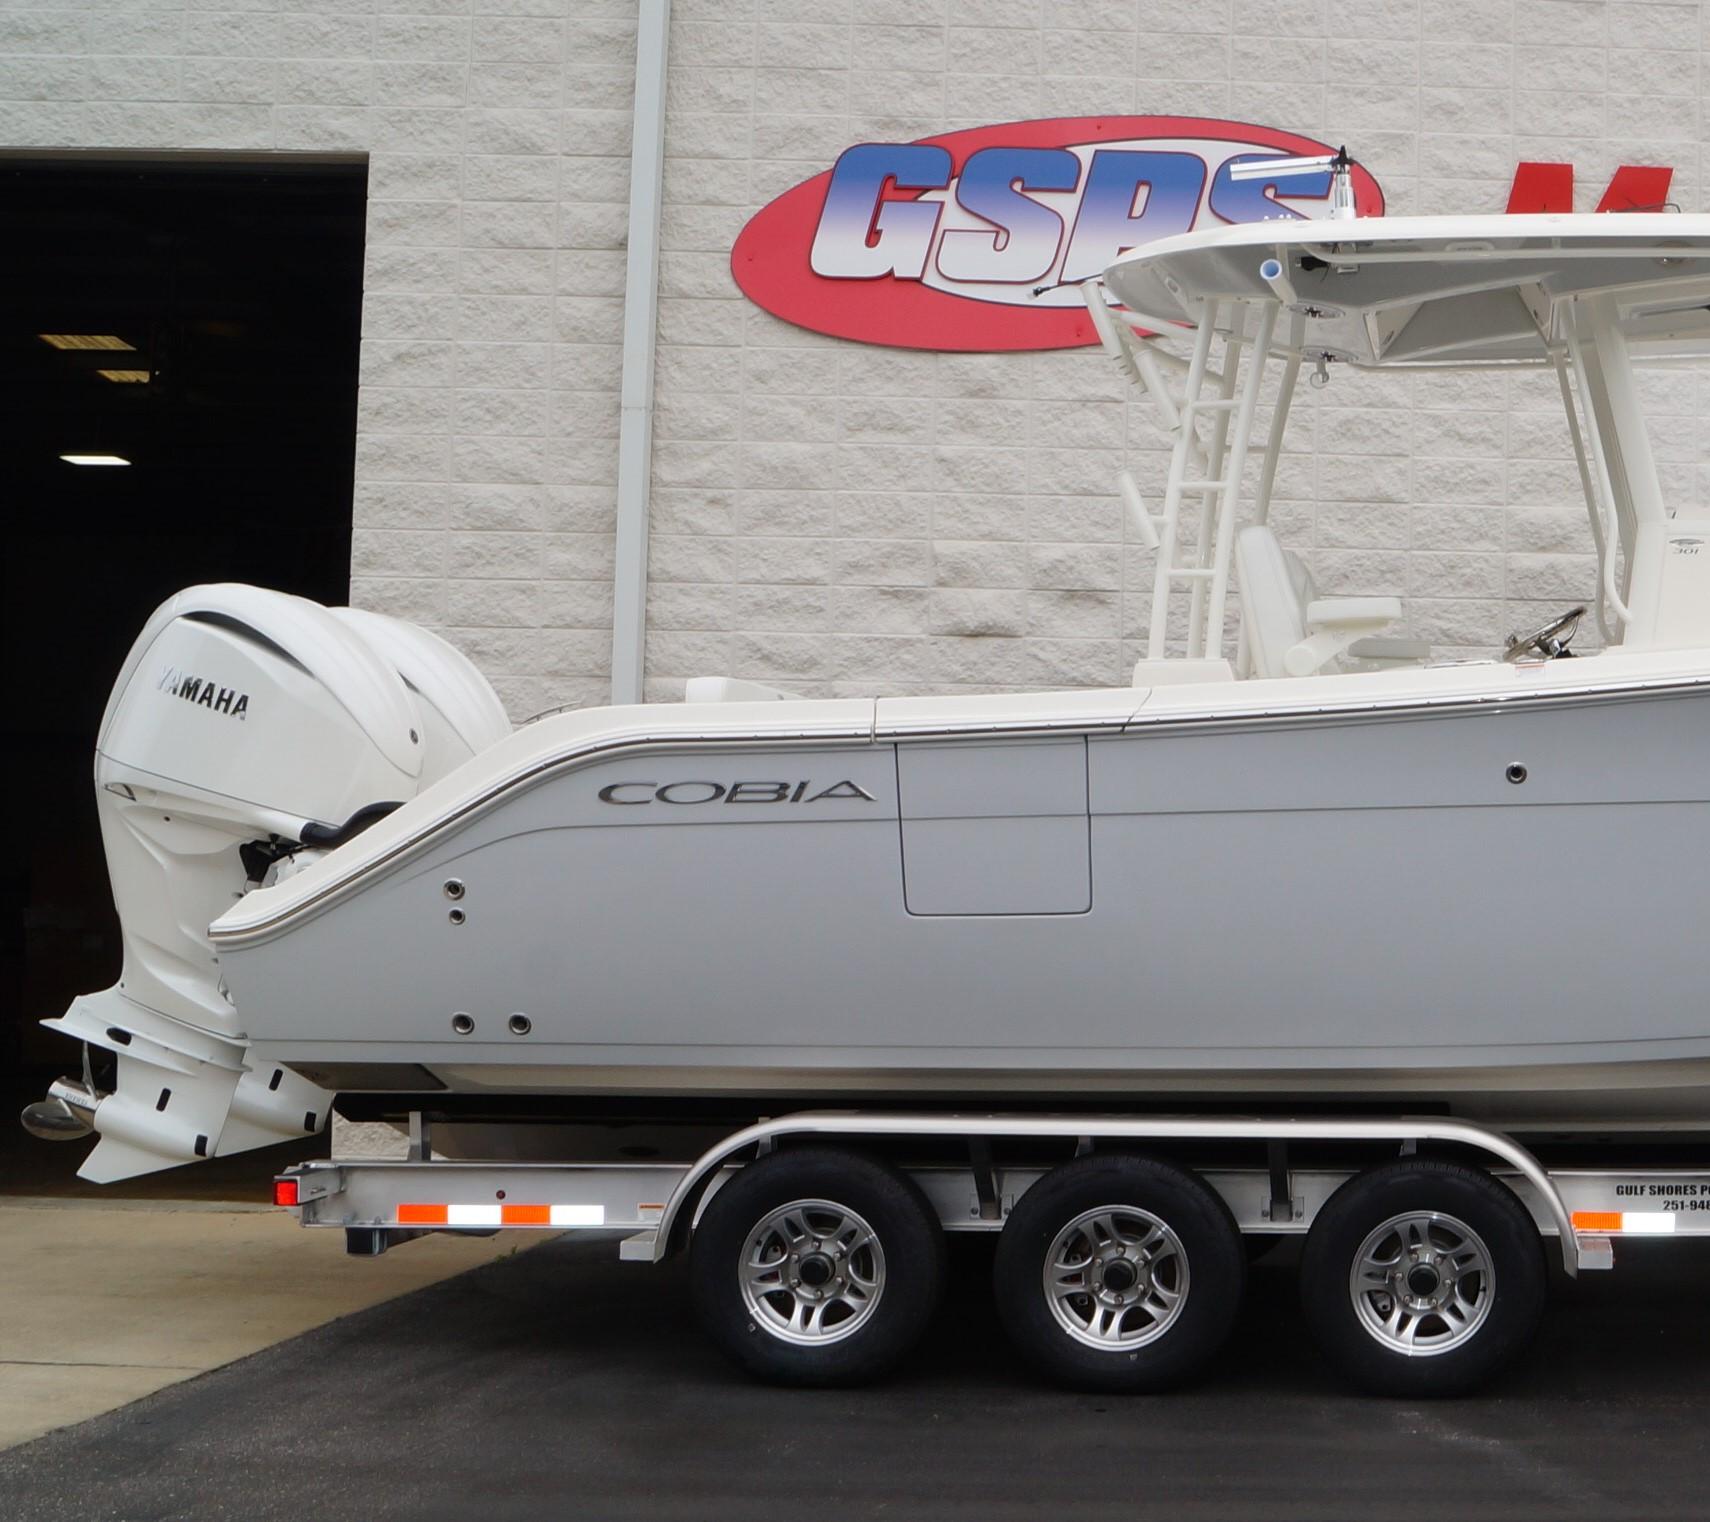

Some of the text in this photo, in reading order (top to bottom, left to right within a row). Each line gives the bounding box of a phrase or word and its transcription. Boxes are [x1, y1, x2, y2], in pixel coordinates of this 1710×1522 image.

[157, 664, 249, 721] YAMAHA
[597, 779, 878, 805] COBIA
[1615, 1184, 1646, 1196] GULF
[1649, 1184, 1698, 1196] SHORES
